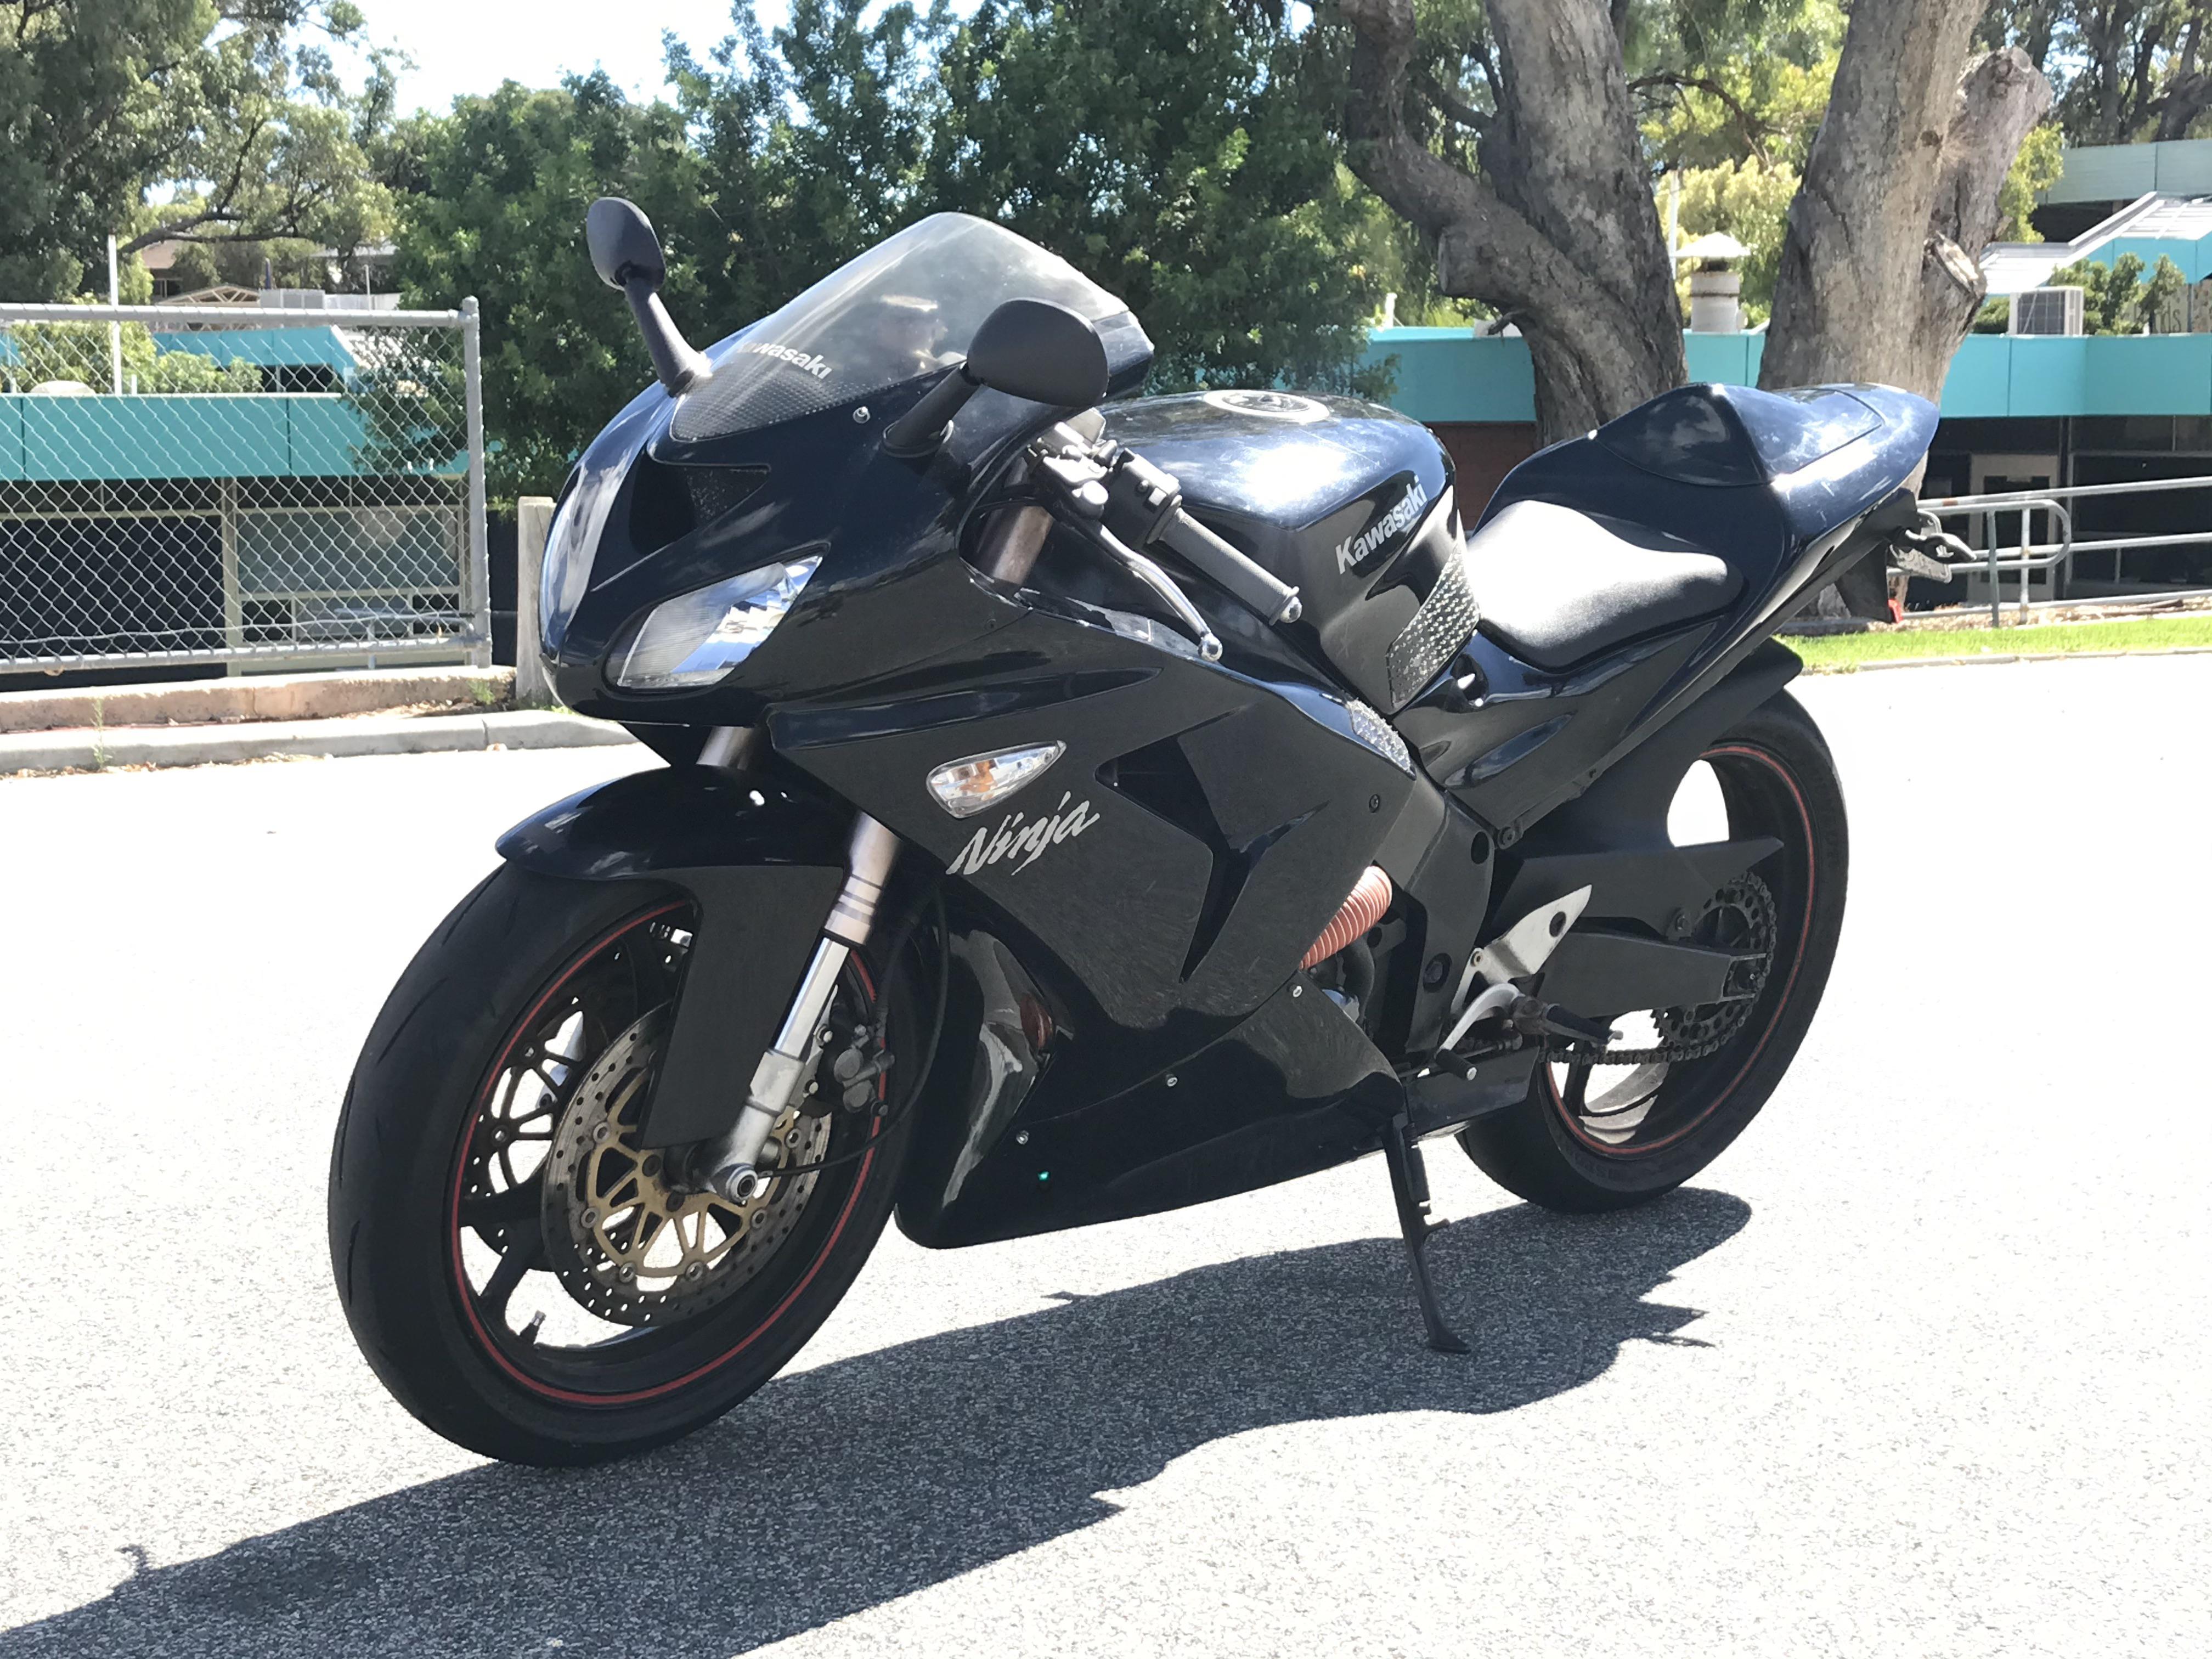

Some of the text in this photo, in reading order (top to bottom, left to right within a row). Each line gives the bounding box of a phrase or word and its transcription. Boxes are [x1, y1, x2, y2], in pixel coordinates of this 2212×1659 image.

[738, 342, 832, 379] wasaki
[1335, 475, 1427, 575] Kawasaki
[945, 791, 1100, 876] Ninja
